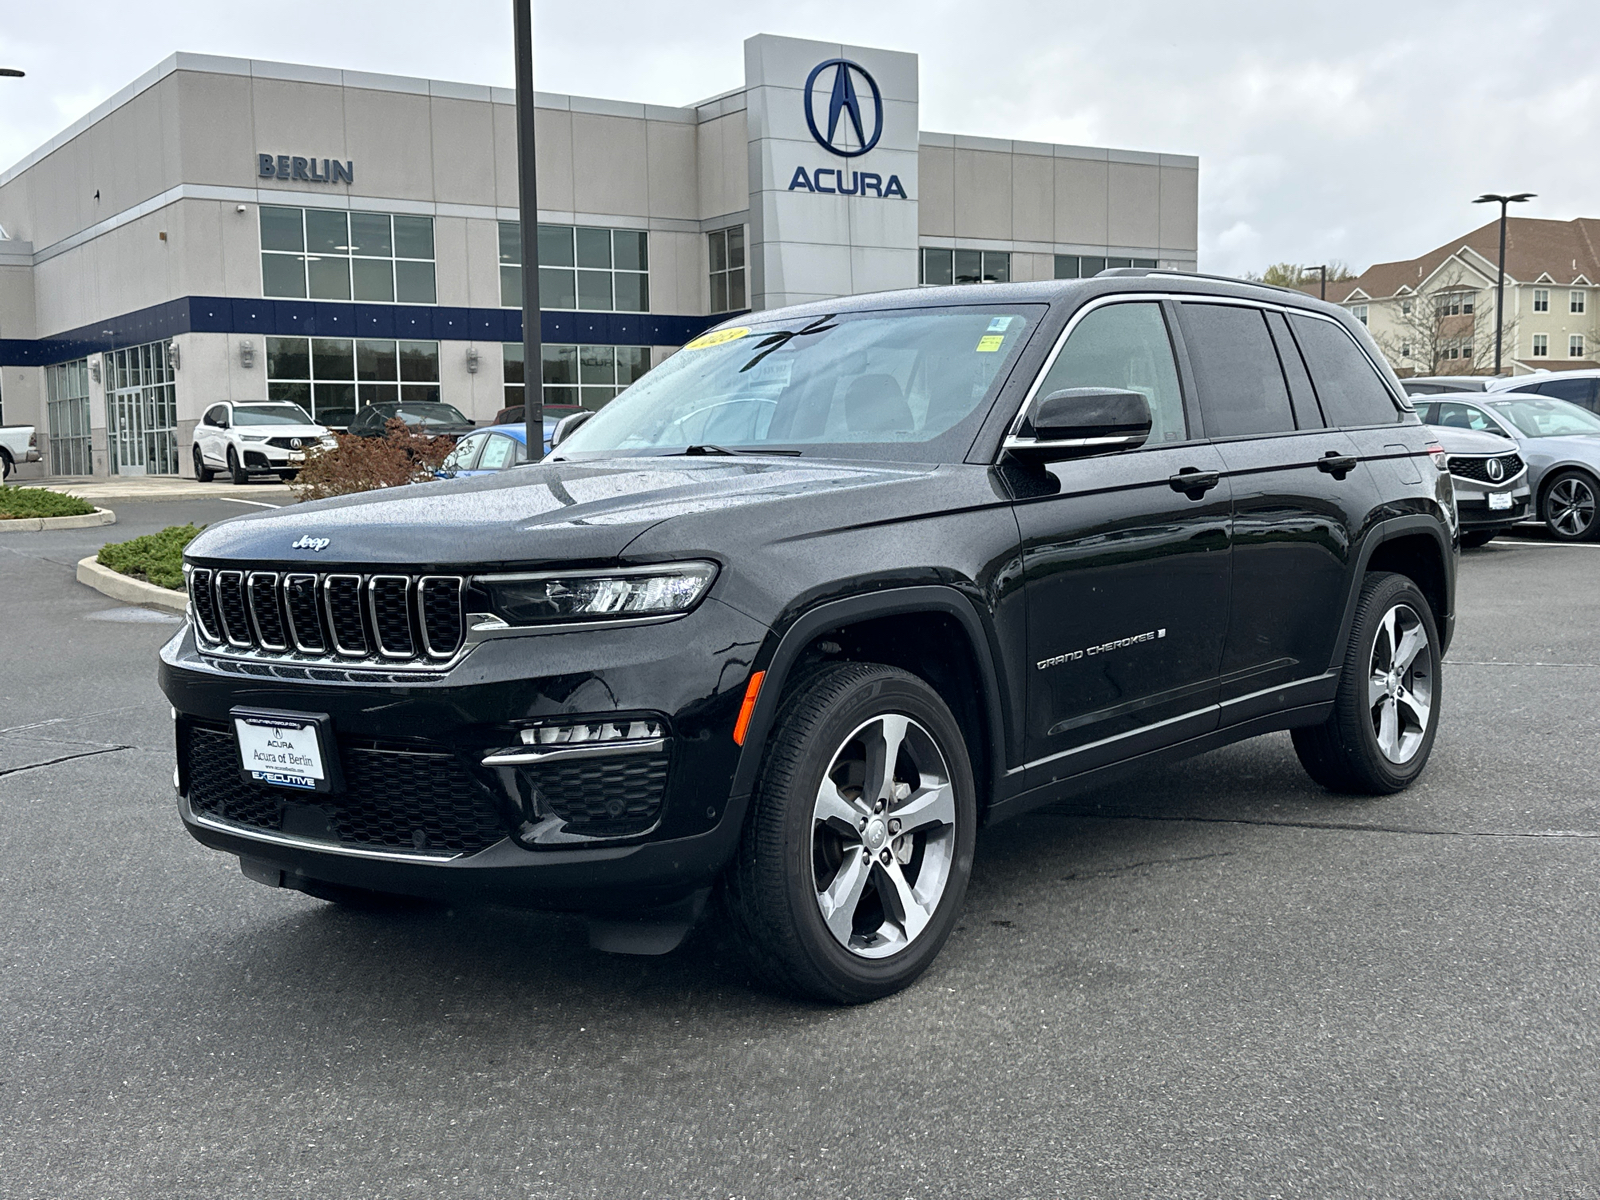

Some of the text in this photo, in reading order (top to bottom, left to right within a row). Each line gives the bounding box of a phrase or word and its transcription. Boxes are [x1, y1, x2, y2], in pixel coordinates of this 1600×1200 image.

[258, 153, 354, 184] BERLIN
[788, 166, 908, 199] ACURA
[292, 534, 330, 551] Jeep
[1036, 631, 1155, 670] GRAND CHEROKEE
[267, 740, 294, 749] ACURA
[253, 749, 314, 767] Acura of Berlin
[251, 771, 316, 786] EXECUTIVE
